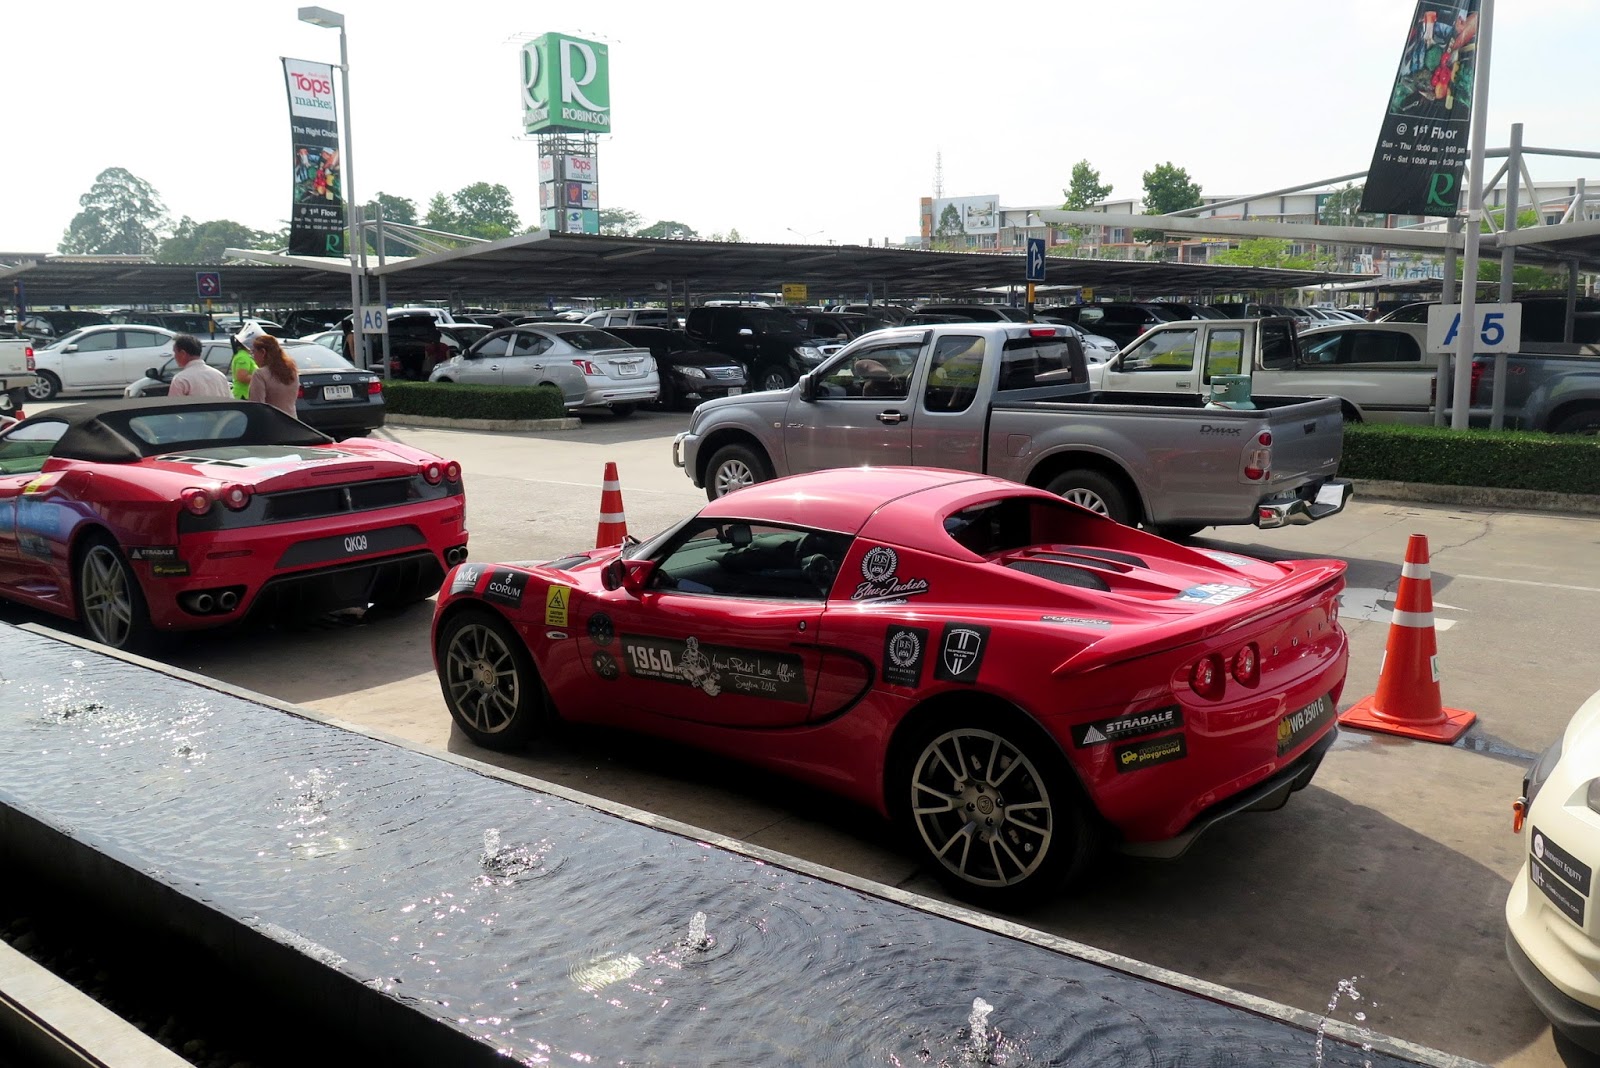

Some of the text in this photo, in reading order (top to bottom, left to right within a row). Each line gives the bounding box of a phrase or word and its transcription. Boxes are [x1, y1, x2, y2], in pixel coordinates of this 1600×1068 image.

[559, 38, 610, 111] R
[290, 72, 331, 98] Tops
[562, 107, 610, 126] ROBINSON
[292, 125, 305, 135] The
[305, 126, 321, 138] Right
[1396, 122, 1407, 135] @
[1413, 124, 1429, 137] 1st
[1400, 142, 1412, 150] Thu
[571, 157, 591, 173] Tops
[1382, 153, 1391, 161] Fri
[1426, 172, 1456, 207] R
[320, 208, 338, 217] Floor
[325, 234, 343, 253] R
[344, 534, 368, 552] QKQ9
[489, 582, 521, 597] CORUM
[851, 576, 929, 600] Blue Jackets
[627, 645, 674, 673] 1960
[776, 662, 796, 683] Affair
[1105, 710, 1173, 733] STRADALE
[1290, 712, 1304, 734] WB
[1317, 697, 1324, 713] G
[1138, 745, 1181, 762] playground
